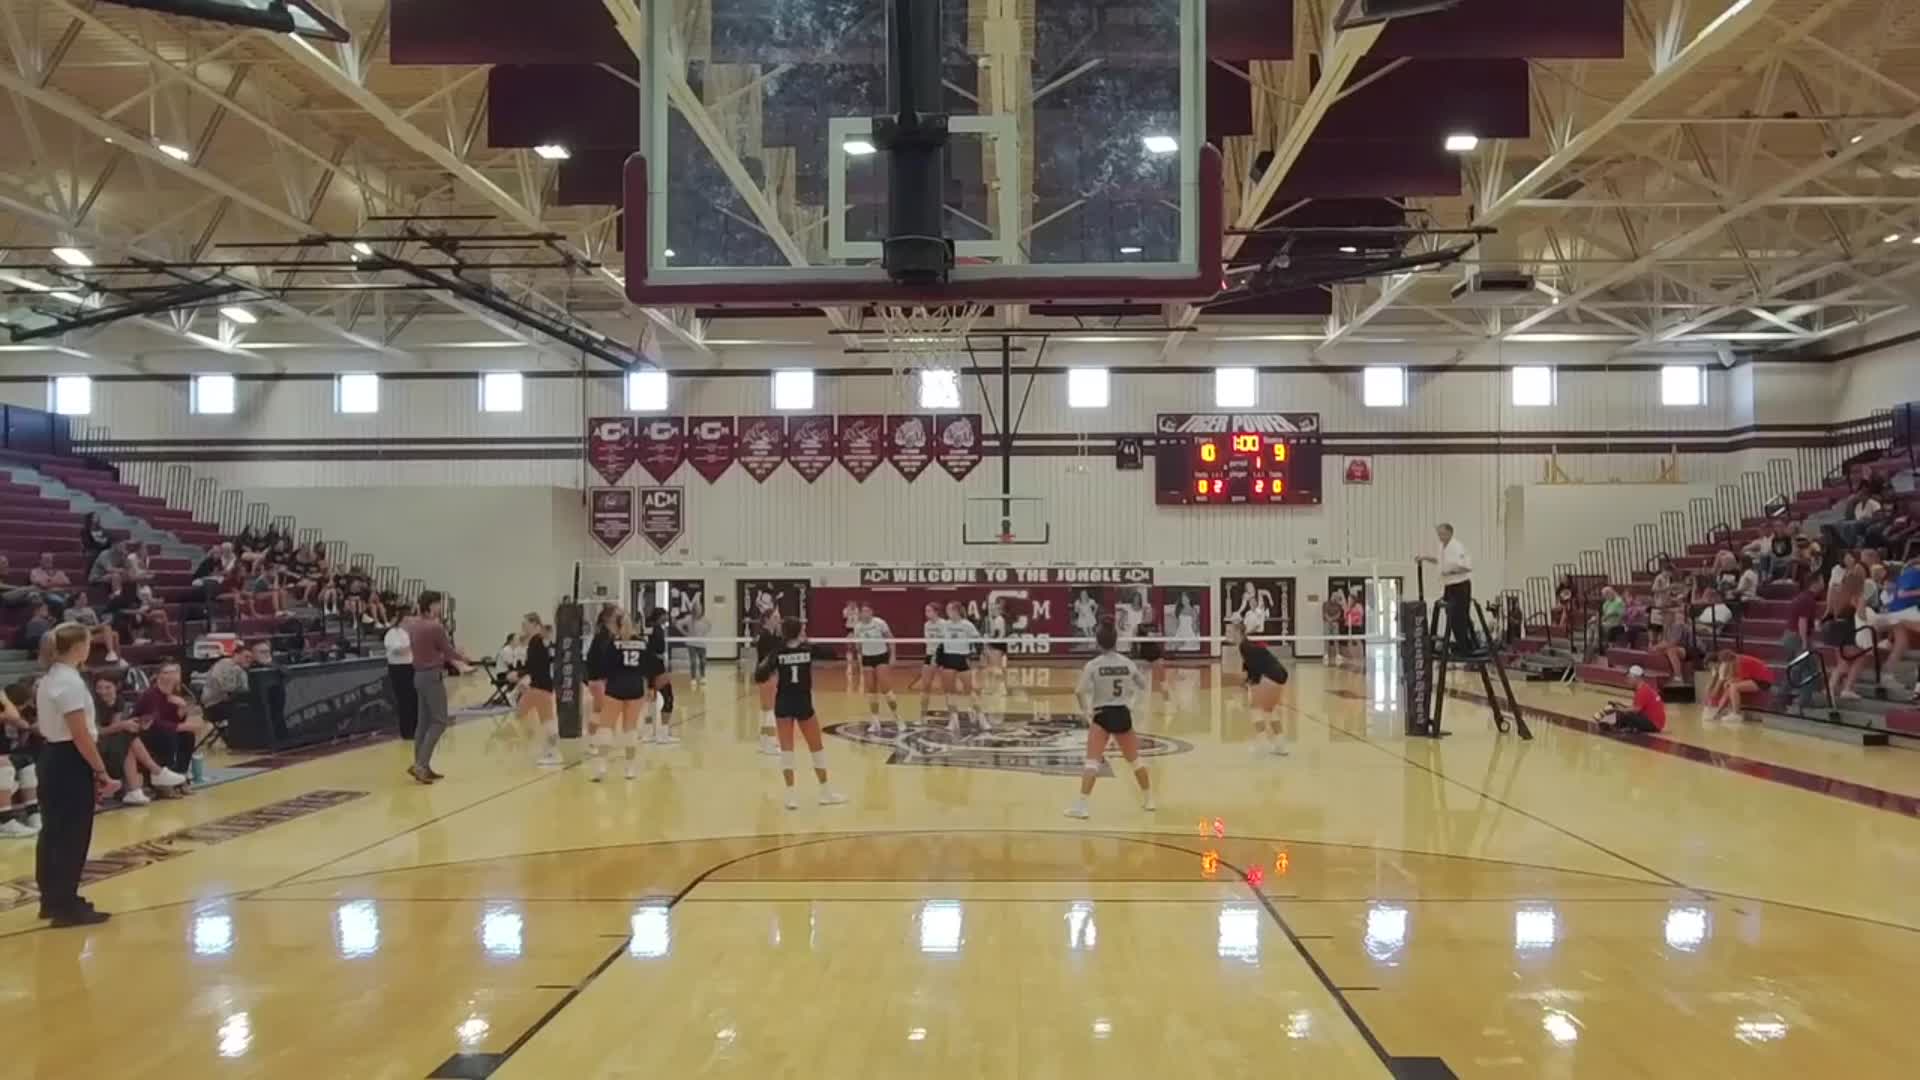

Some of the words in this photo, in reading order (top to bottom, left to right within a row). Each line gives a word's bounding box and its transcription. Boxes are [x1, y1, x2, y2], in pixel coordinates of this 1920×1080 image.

[1177, 415, 1231, 433] TIGER
[1232, 415, 1298, 433] POWER
[1233, 435, 1259, 451] 1:00
[1274, 443, 1285, 461] 9
[645, 492, 677, 507] ACM
[893, 568, 977, 582] WELCOME
[984, 568, 1008, 582] TO
[1016, 568, 1048, 582] THE
[1056, 568, 1121, 582] JUNGLE
[623, 650, 640, 667] 12
[791, 665, 800, 683] 1
[1112, 679, 1122, 696] 5
